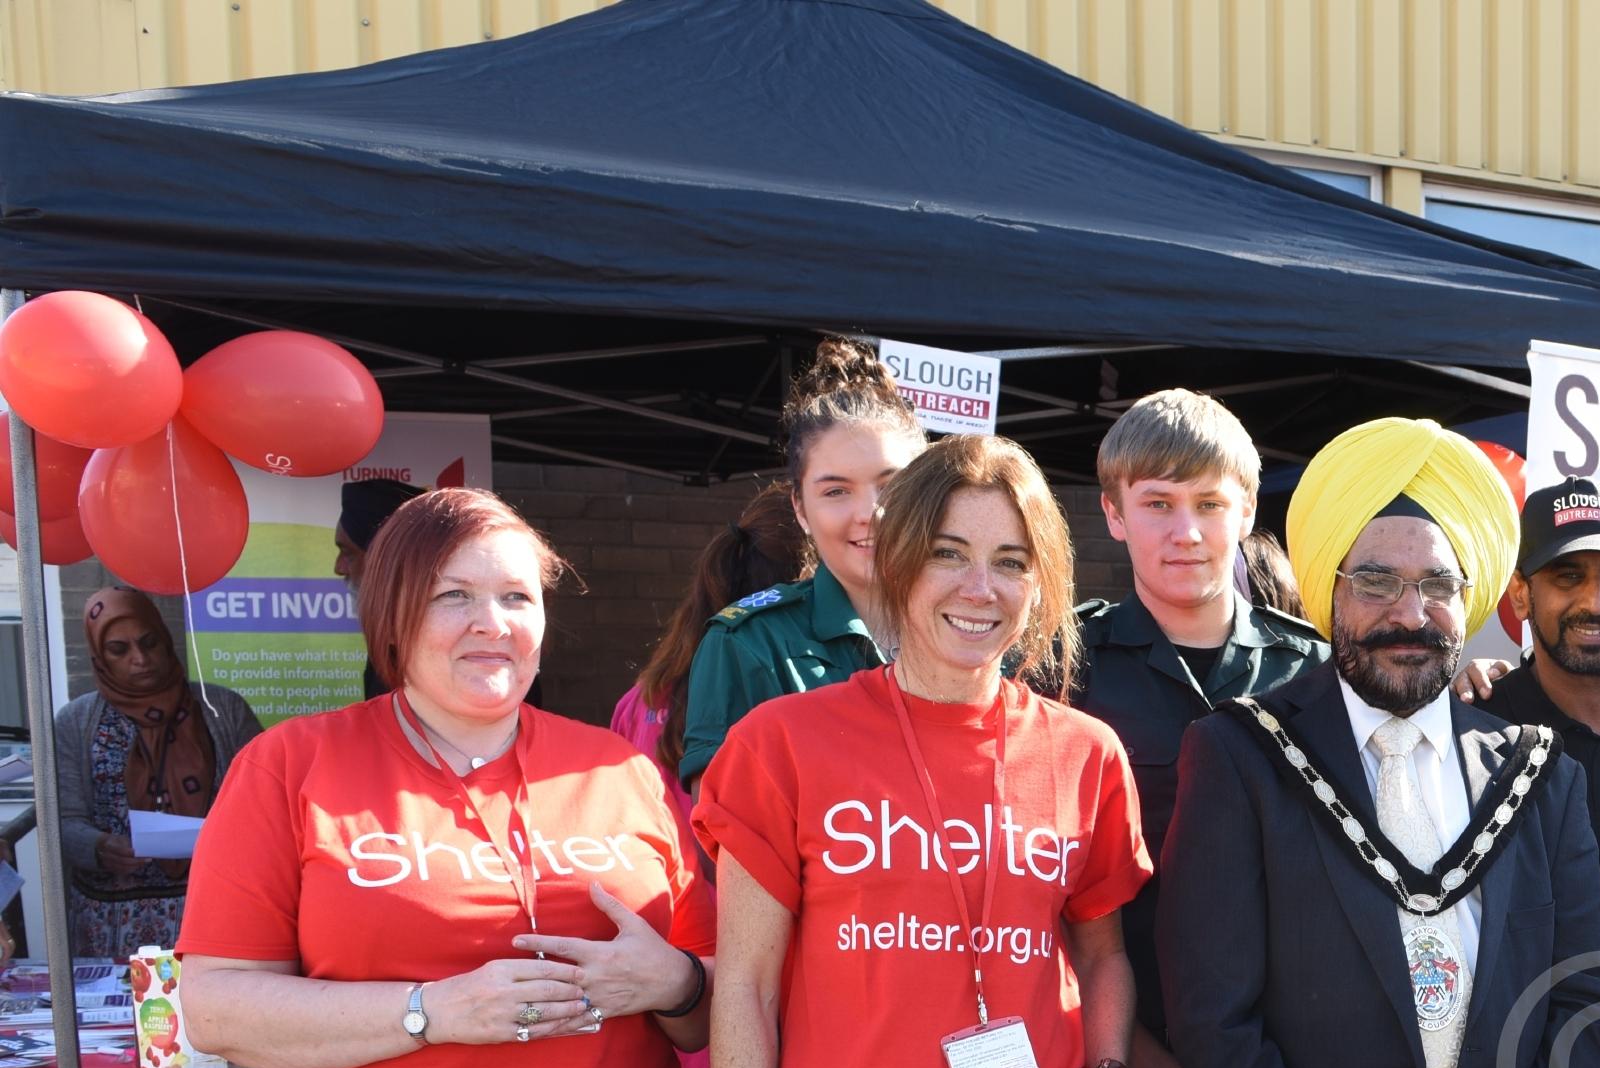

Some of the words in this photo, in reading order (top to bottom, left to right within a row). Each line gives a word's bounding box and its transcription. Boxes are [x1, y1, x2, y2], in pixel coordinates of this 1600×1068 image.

[886, 355, 992, 395] SLOUGH
[343, 467, 412, 482] TURNING
[206, 591, 265, 619] GET
[212, 649, 231, 661] Do
[234, 651, 257, 664] you
[261, 649, 291, 661] have
[295, 649, 326, 661] what
[330, 649, 340, 661] it
[214, 668, 227, 679] to
[231, 667, 281, 682] provide
[284, 667, 360, 679] information
[270, 686, 284, 697] to
[287, 685, 330, 700] people
[333, 685, 361, 697] with
[276, 702, 322, 714] alcohol
[822, 800, 1079, 887] Shelter
[1411, 928, 1437, 937] MAYOR
